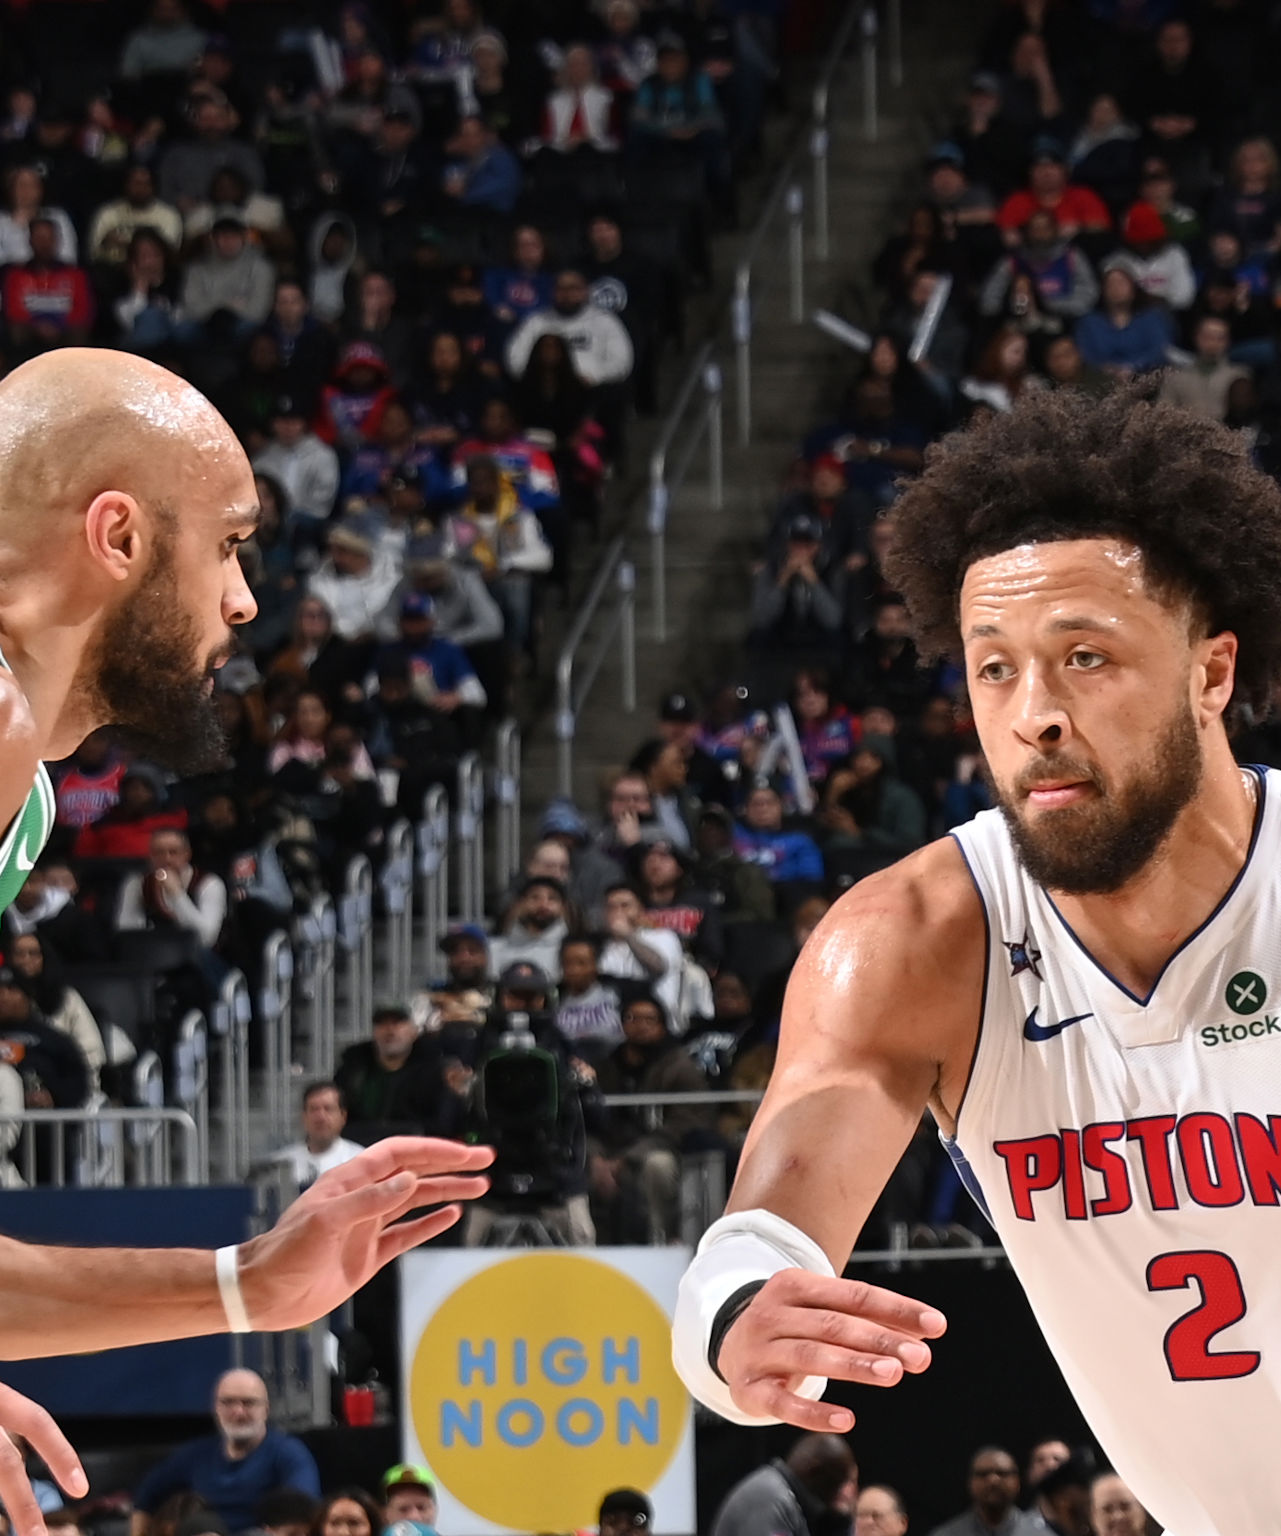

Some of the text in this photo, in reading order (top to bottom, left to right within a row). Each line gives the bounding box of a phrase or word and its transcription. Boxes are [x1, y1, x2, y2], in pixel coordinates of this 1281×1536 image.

[1145, 1249, 1261, 1382] 2
[458, 1337, 640, 1386] HIGH
[440, 1397, 659, 1446] NOON
